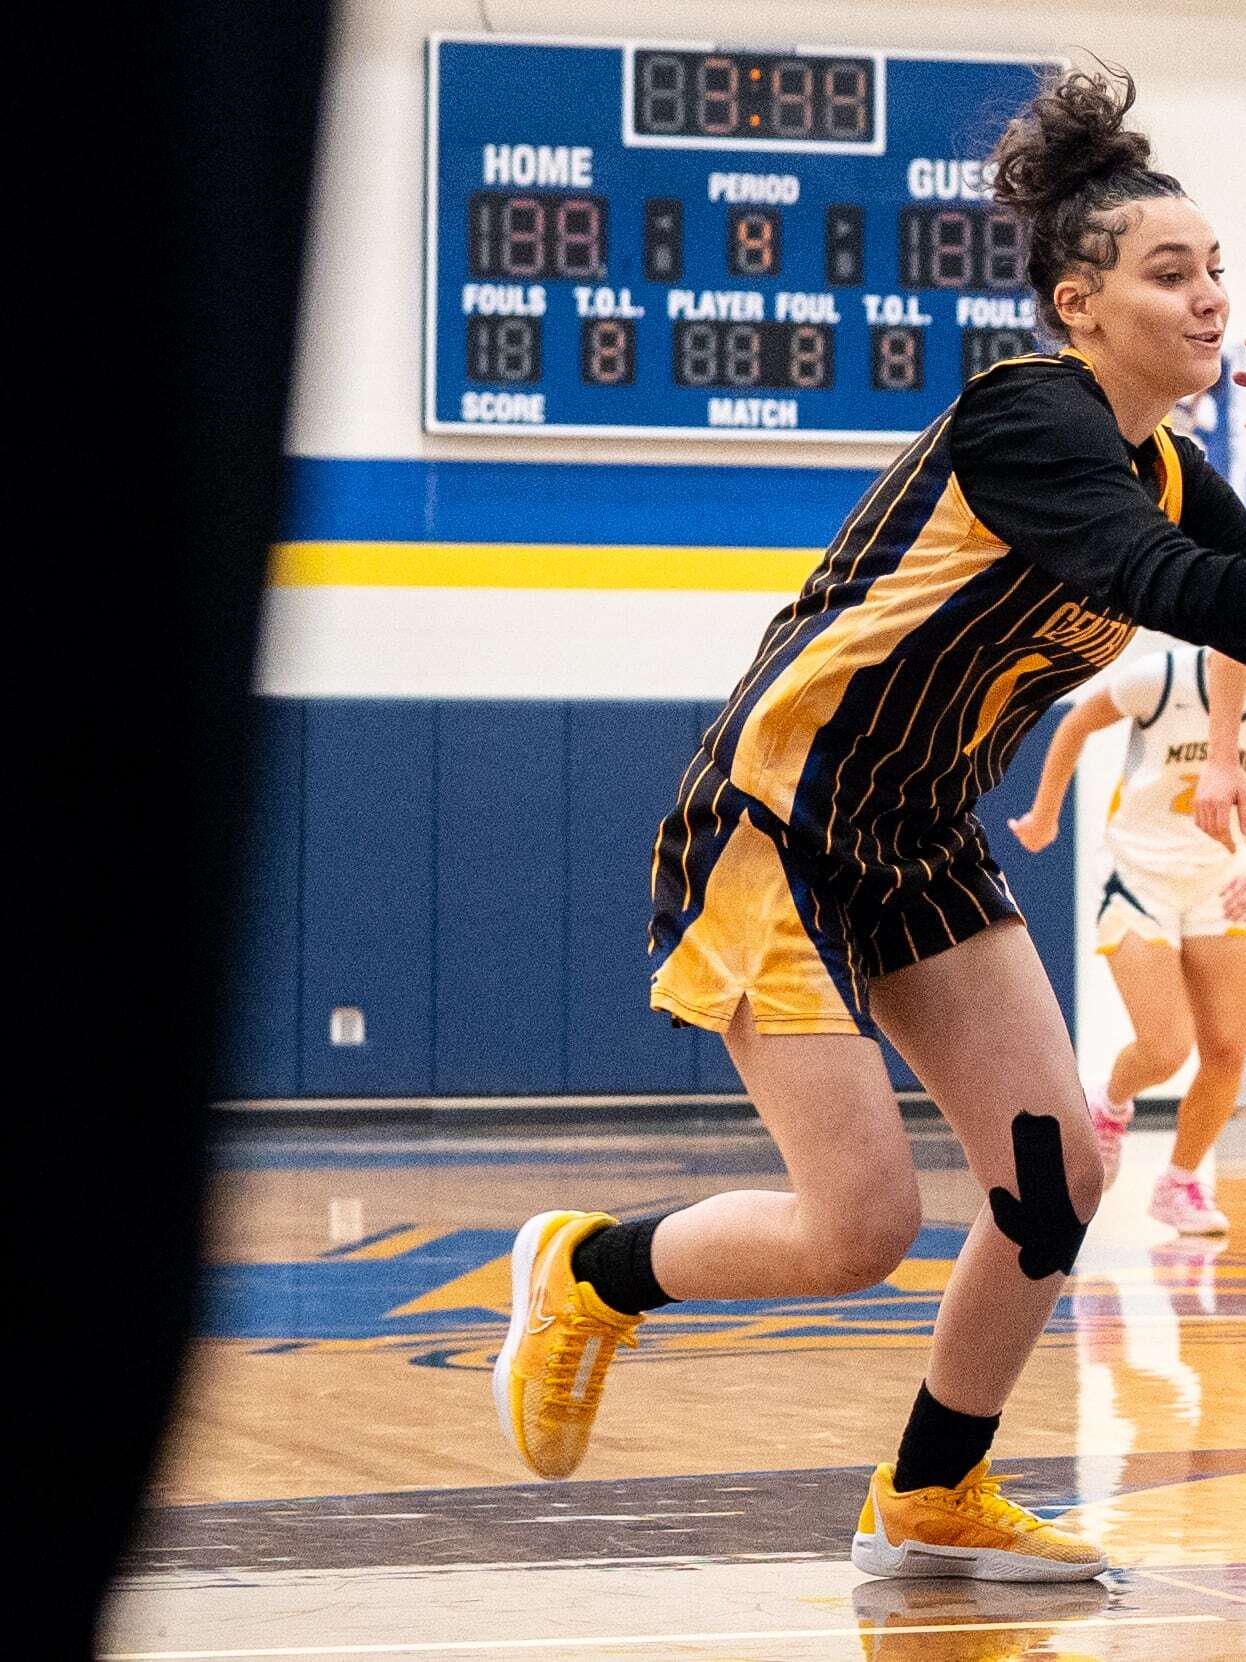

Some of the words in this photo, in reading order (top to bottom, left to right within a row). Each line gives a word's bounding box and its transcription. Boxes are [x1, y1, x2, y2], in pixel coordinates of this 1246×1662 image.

[483, 143, 594, 188] HOME
[908, 156, 1001, 200] GUES
[707, 171, 801, 205] PERIOD
[461, 283, 548, 319] FOULS
[572, 286, 646, 320] T.O.L.
[666, 288, 766, 322] PLAYER
[774, 291, 842, 325] FOUL
[861, 293, 934, 327] T.O.L.
[461, 390, 547, 424] SCORE
[707, 397, 799, 428] MATCH
